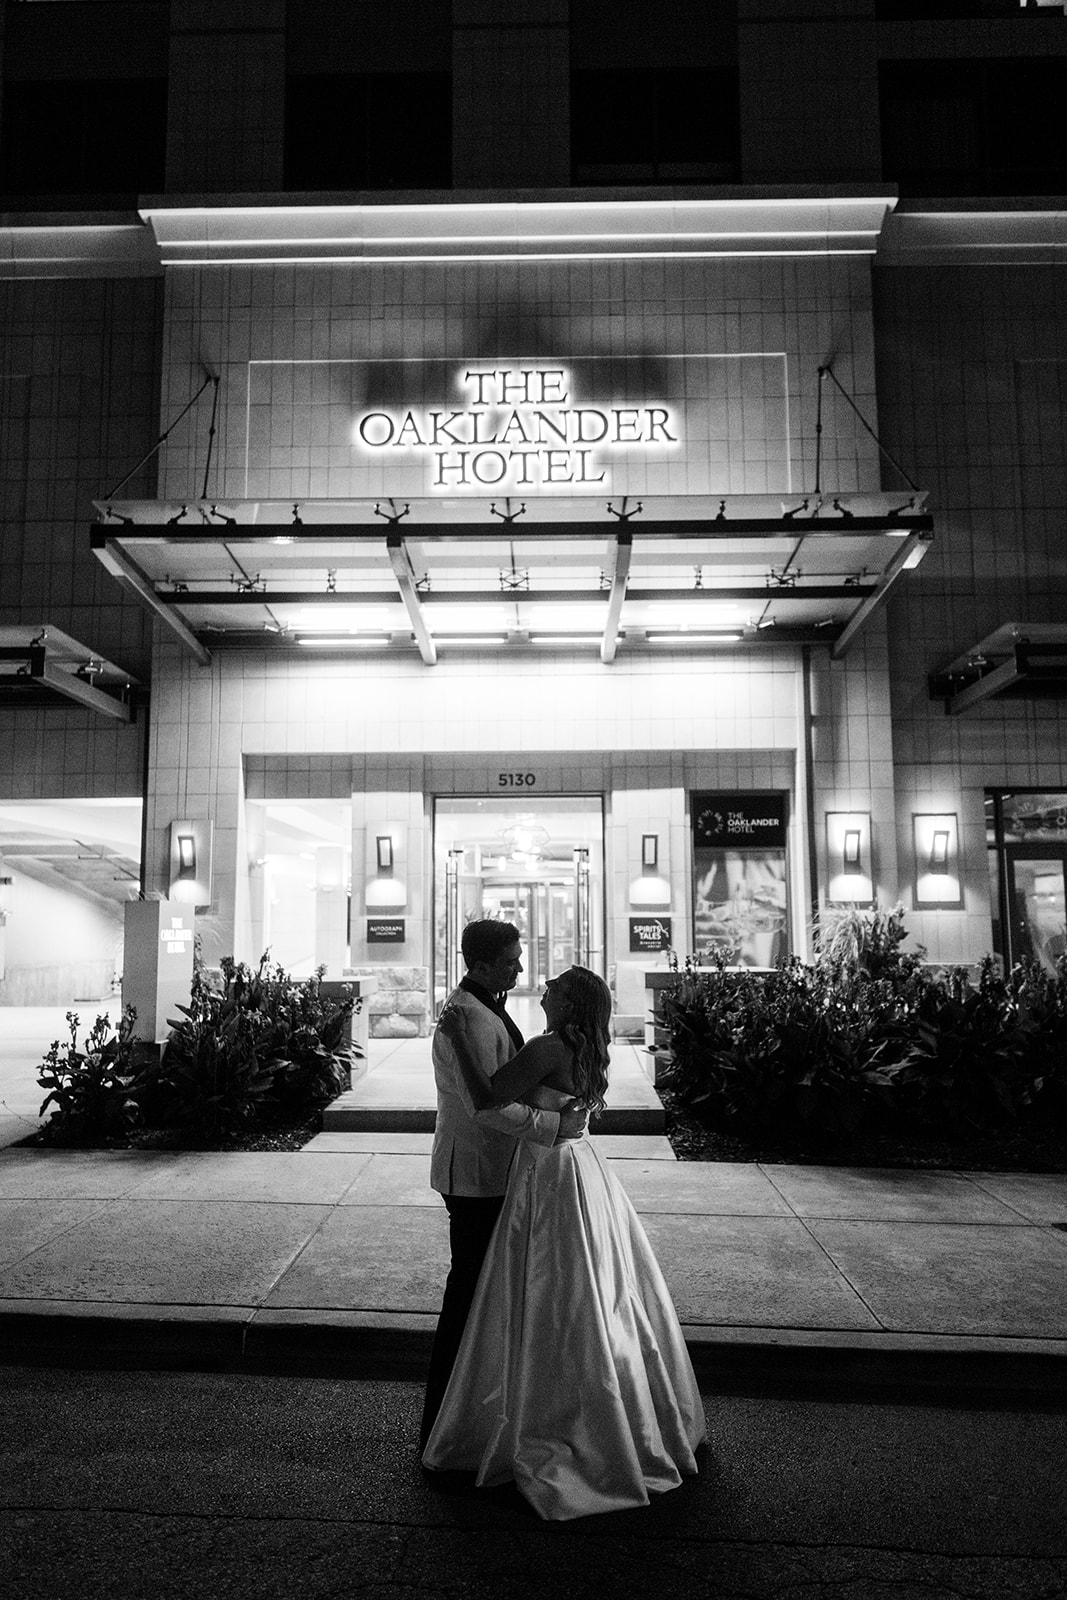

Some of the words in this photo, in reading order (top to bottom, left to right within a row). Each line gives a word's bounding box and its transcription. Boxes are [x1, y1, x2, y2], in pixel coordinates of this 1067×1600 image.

[465, 370, 568, 405] THE
[359, 409, 677, 446] OAKLANDER
[433, 450, 606, 485] HOTEL
[499, 773, 536, 786] 5130
[727, 811, 744, 819] THE
[727, 818, 780, 827] OAKLANDER
[633, 924, 661, 933] SPIRITS
[640, 932, 662, 940] TALES
